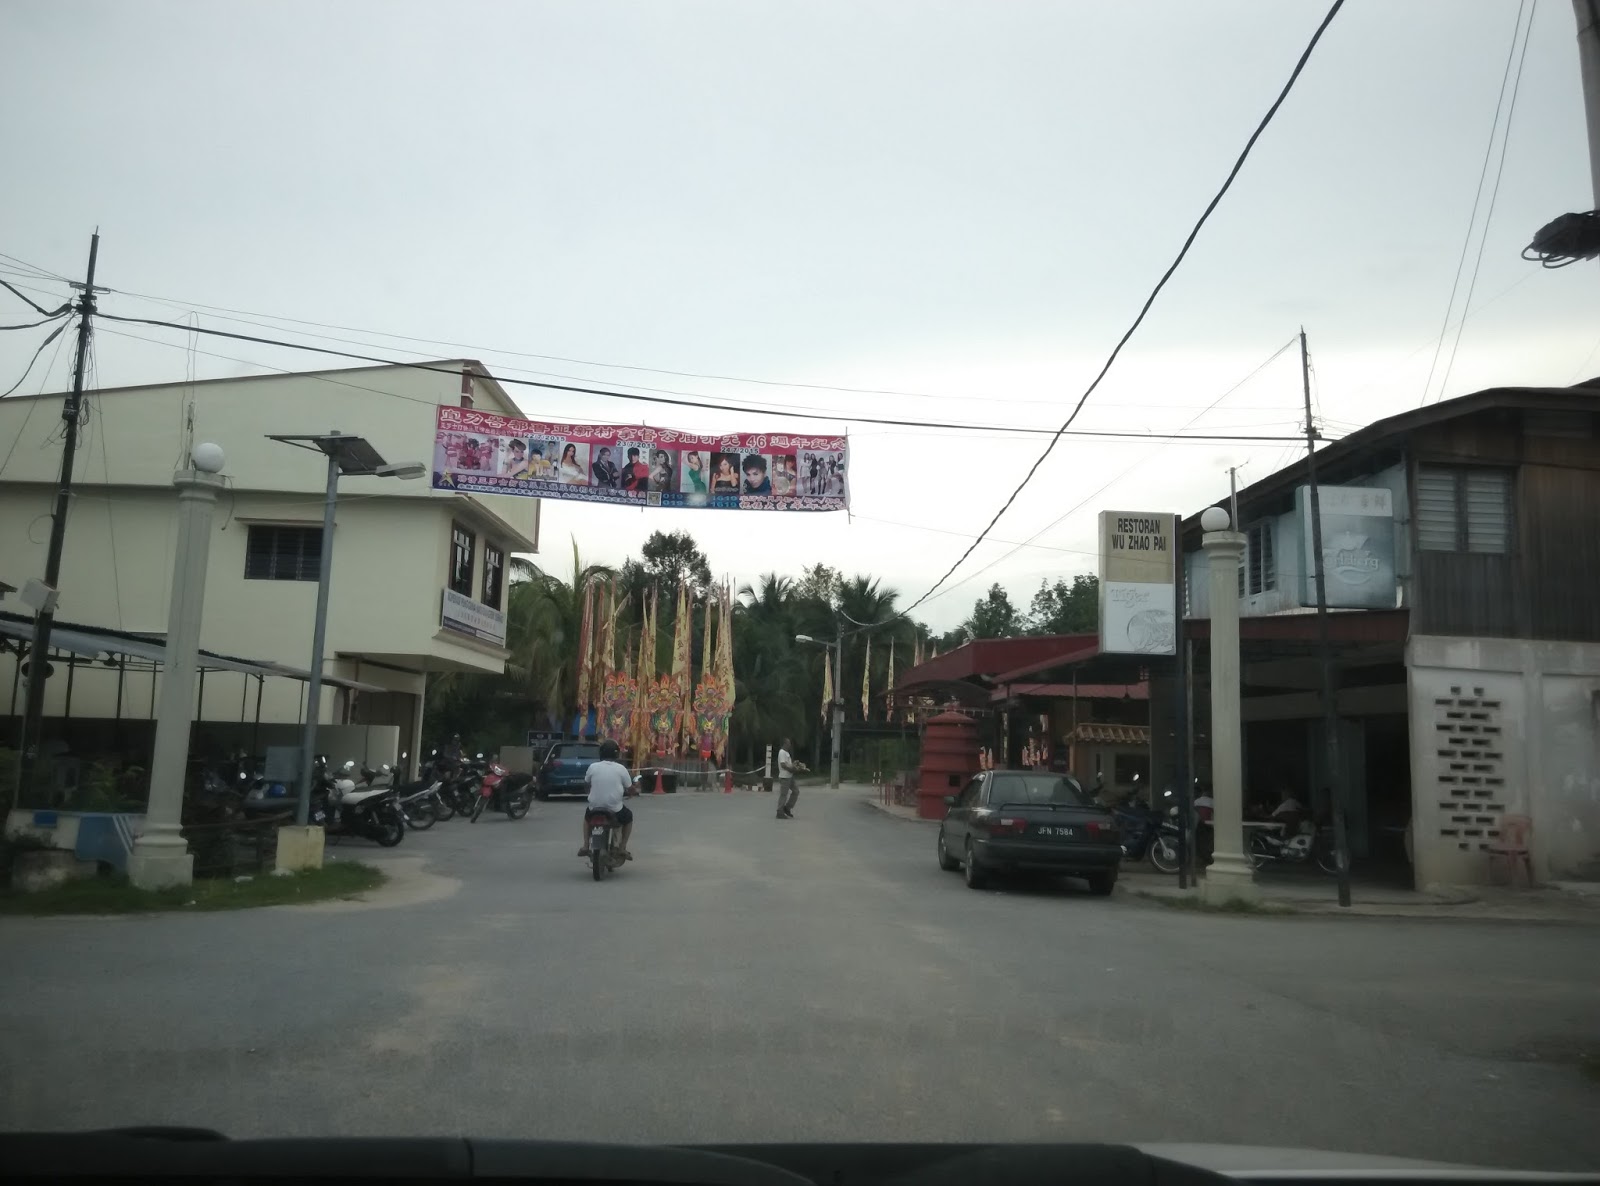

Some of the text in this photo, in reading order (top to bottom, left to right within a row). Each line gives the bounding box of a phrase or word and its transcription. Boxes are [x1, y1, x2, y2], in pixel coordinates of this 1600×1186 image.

[524, 433, 566, 442] 22/7/2015
[745, 435, 767, 448] 46
[616, 440, 657, 450] 23/7/2015
[720, 445, 760, 454] 24/7/2015
[1117, 518, 1161, 534] RESTORAN
[1112, 534, 1167, 551] WU ZHAO PAI
[1037, 826, 1074, 837] JFN 7584
